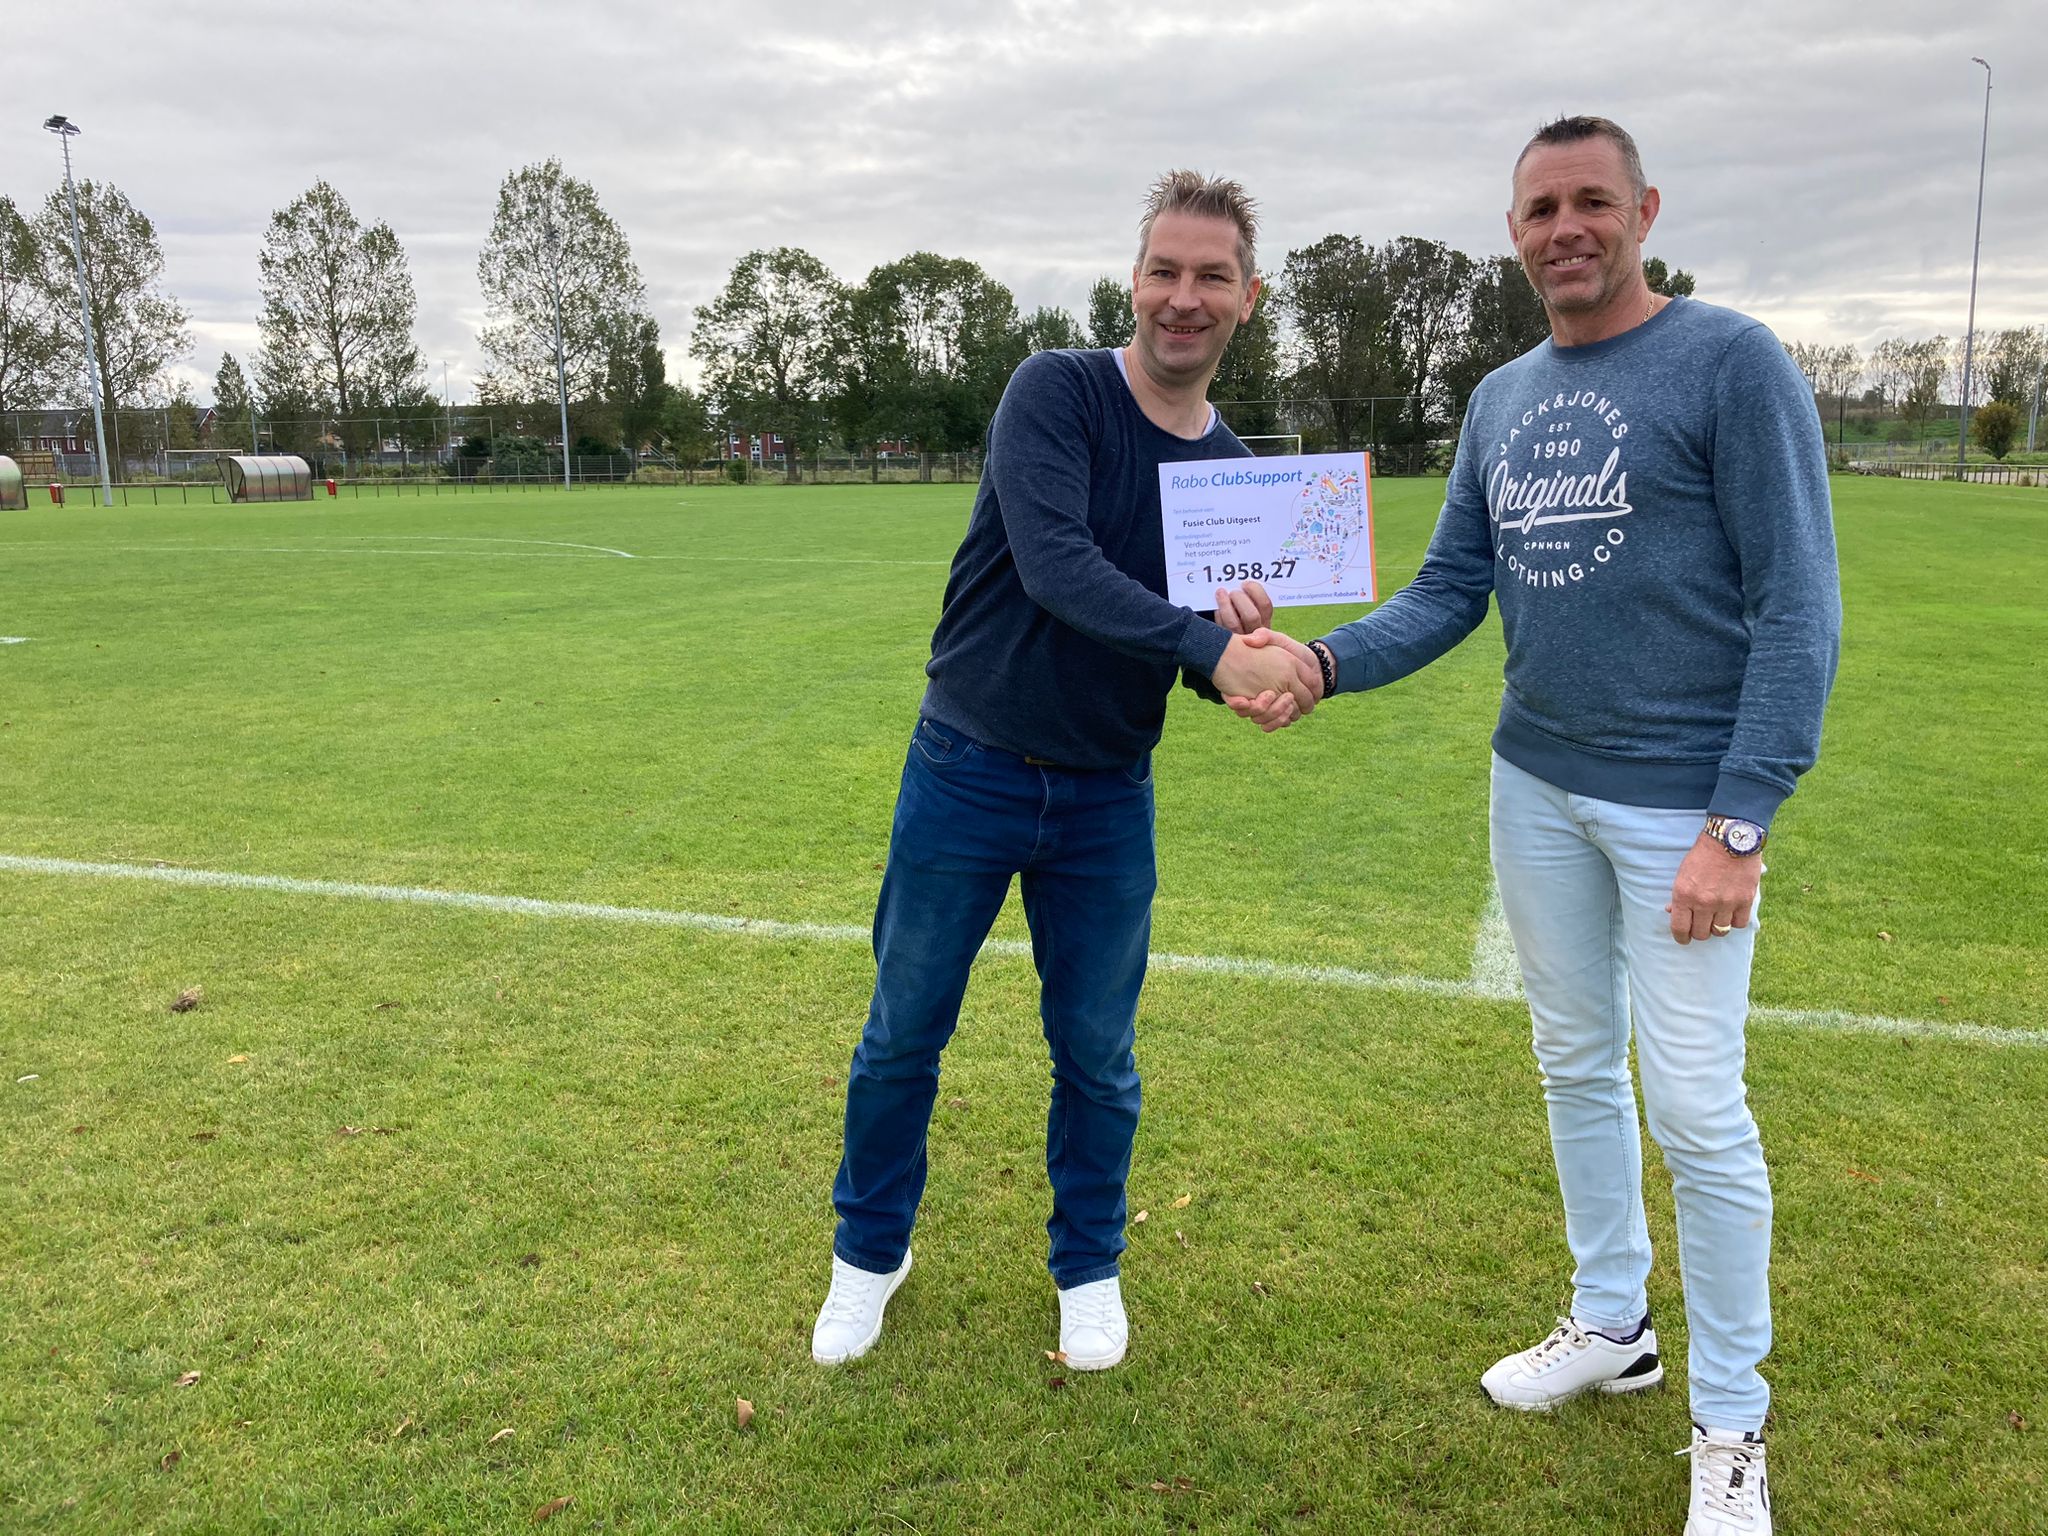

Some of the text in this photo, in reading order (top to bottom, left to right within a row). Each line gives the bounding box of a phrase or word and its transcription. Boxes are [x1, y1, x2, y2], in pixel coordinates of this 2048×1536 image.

[1499, 390, 1629, 455] JACK&JONES
[1548, 422, 1572, 433] EST
[1532, 438, 1581, 459] 1990
[1171, 469, 1303, 490] Rabo ClubSupport
[1488, 446, 1633, 535] Originals
[1183, 516, 1261, 528] Fusie Club Uitgeest
[1184, 539, 1237, 549] Verduurzaming
[1184, 548, 1232, 558] het sportpark
[1523, 541, 1570, 551] CPNHGN
[1497, 527, 1625, 588] LOTHING.CO
[1187, 560, 1297, 584] € 1.958,27
